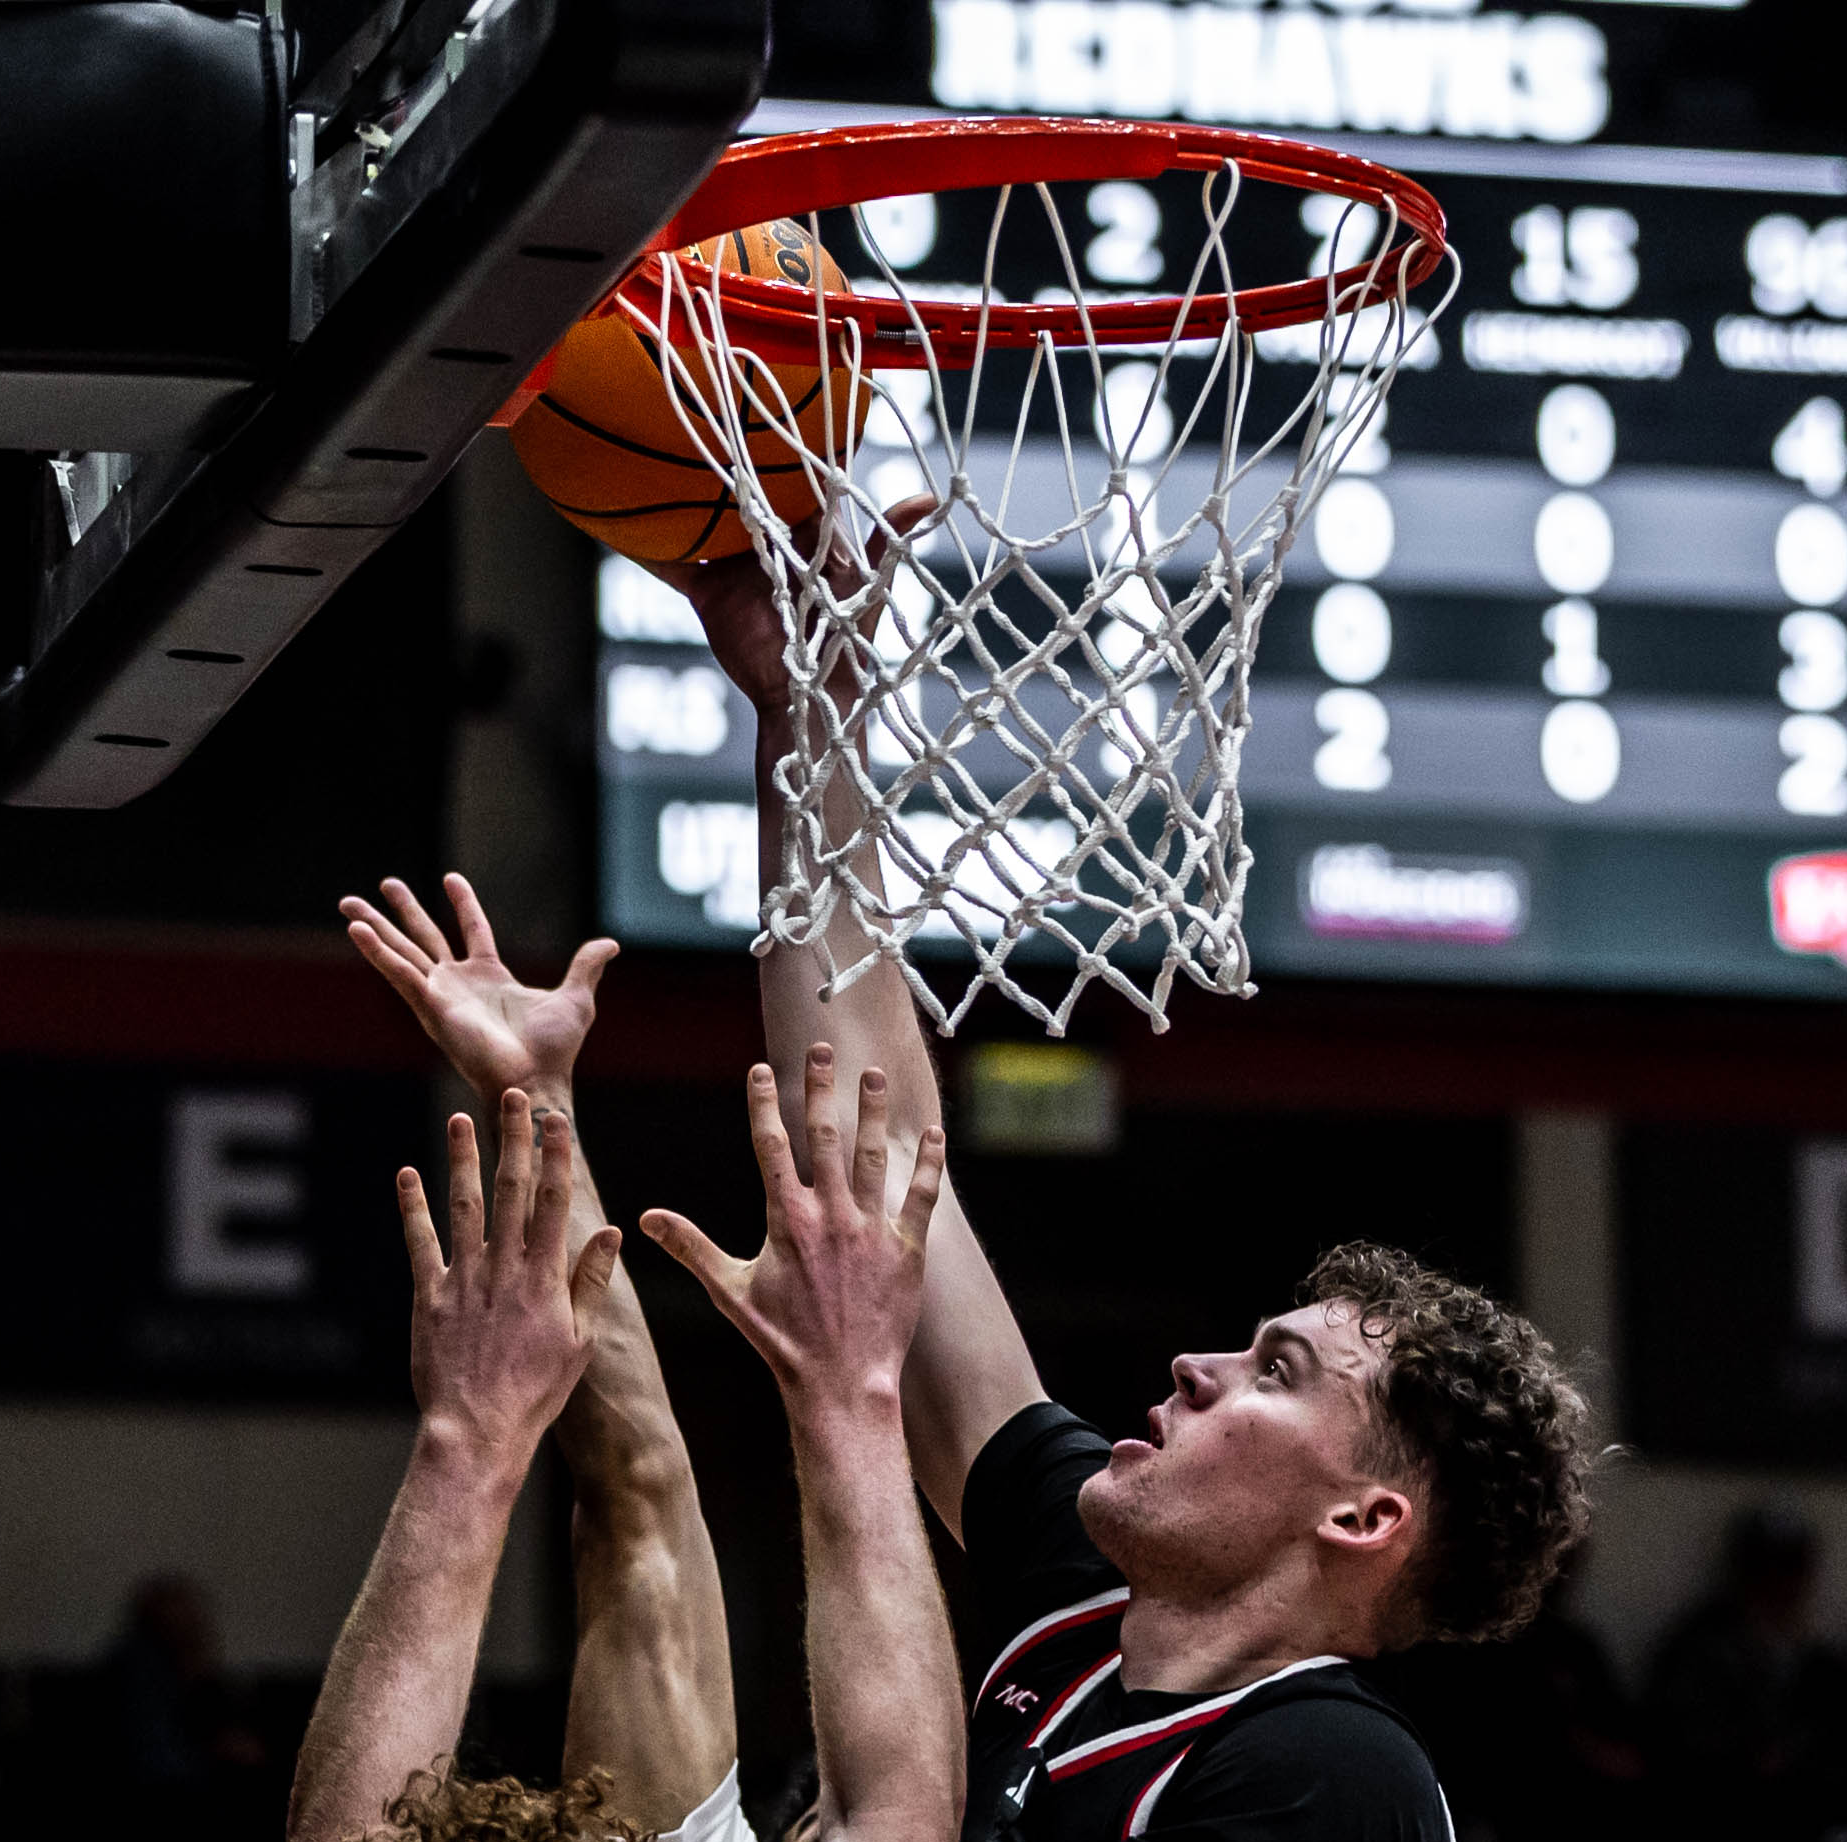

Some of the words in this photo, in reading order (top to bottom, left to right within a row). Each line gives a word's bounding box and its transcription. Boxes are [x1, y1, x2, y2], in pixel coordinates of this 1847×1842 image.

[934, 4, 1609, 143] REDHAWKS
[1086, 181, 1165, 284] 2
[1511, 205, 1641, 311] 15
[1536, 384, 1616, 487] 0
[1314, 476, 1394, 580] 0
[1534, 491, 1615, 595] 0
[1312, 582, 1392, 684] 0
[1542, 599, 1612, 697] 1
[1314, 688, 1392, 791] 2
[1541, 700, 1620, 803] 0
[163, 1093, 311, 1292] E
